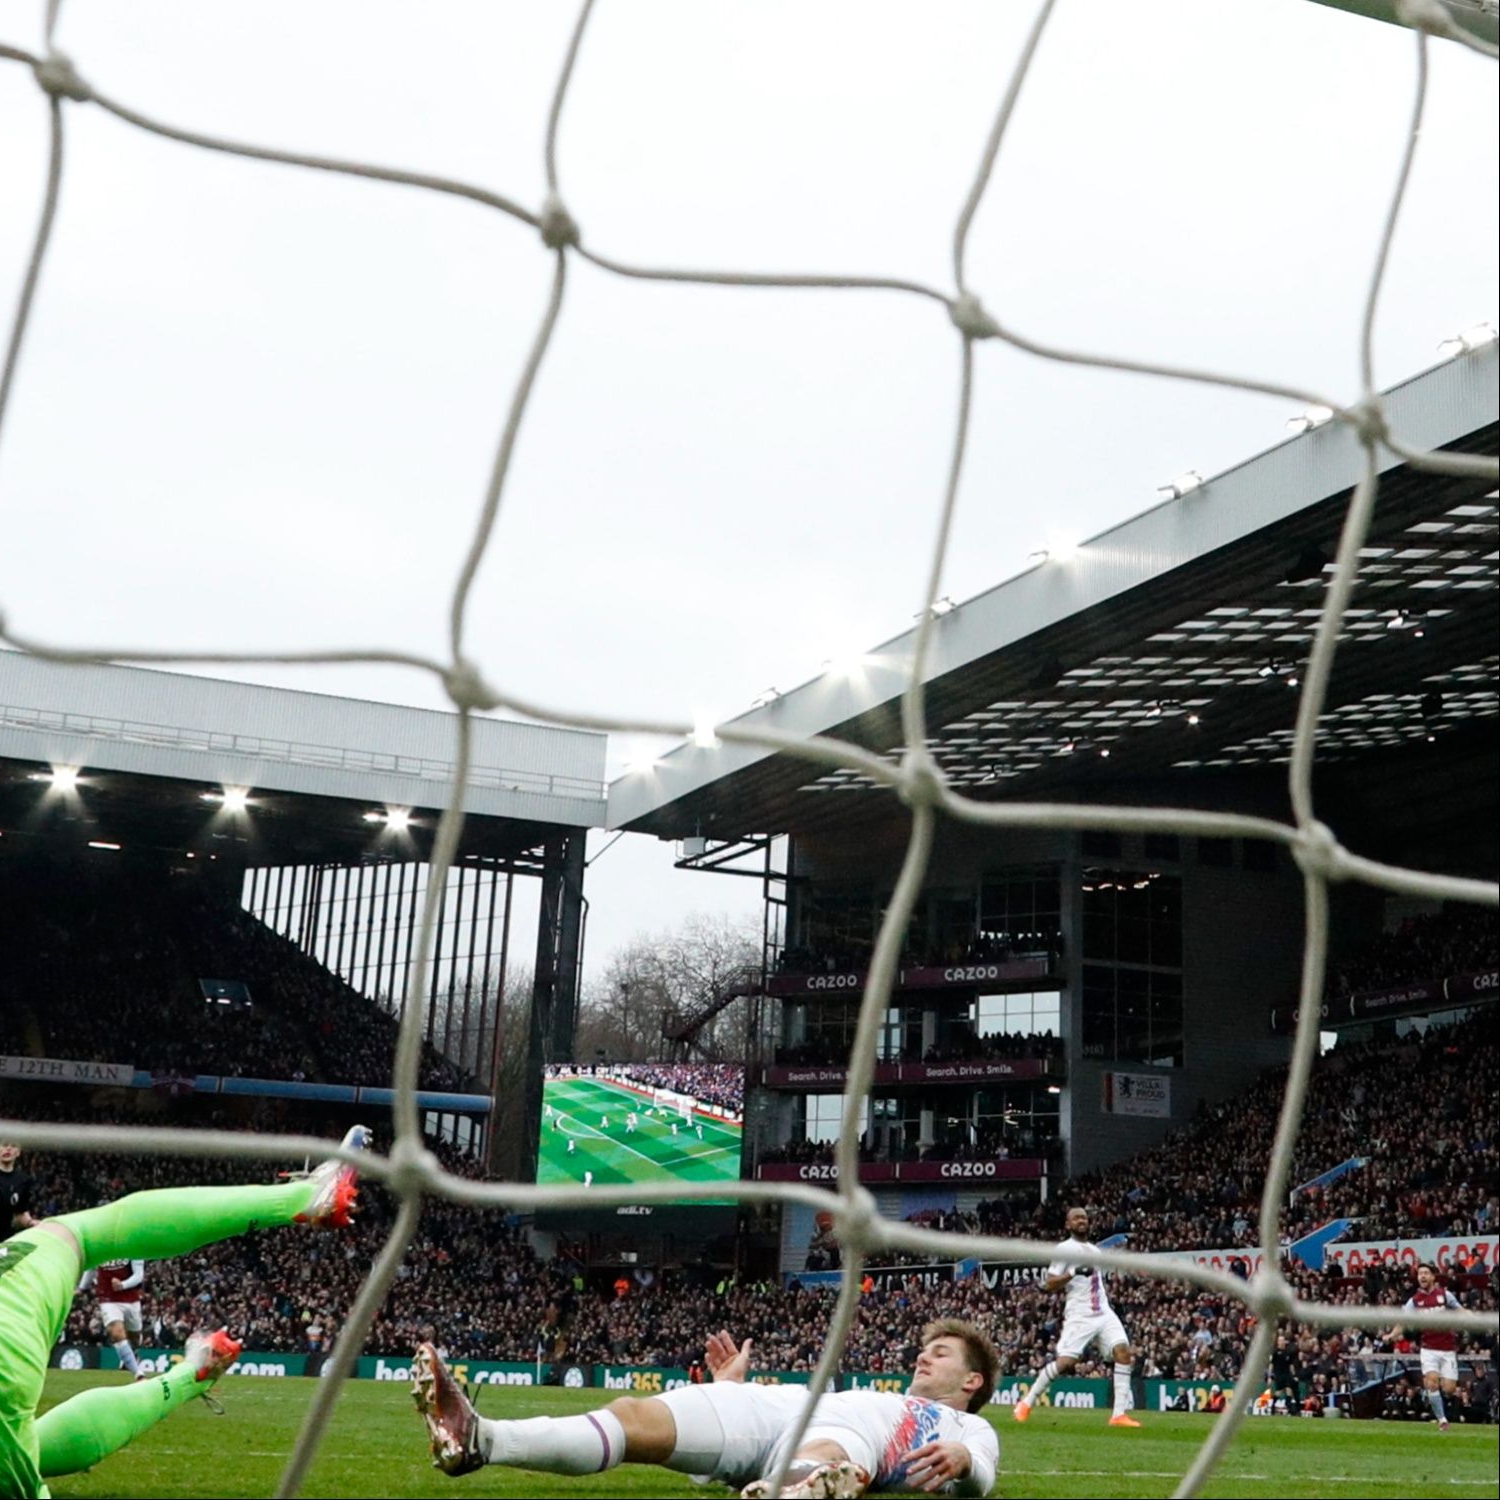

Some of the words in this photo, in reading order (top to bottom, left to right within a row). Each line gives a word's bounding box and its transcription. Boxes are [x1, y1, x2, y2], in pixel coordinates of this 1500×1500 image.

[944, 966, 998, 981] CAZOO
[807, 975, 857, 989] CAZOO
[18, 1063, 65, 1077] 12TH
[73, 1067, 118, 1082] MAN
[926, 1067, 958, 1077] Search.
[960, 1066, 985, 1076] Drive.
[986, 1064, 1015, 1075] Smile.
[800, 1165, 840, 1180] CAZO
[941, 1162, 996, 1176] CAZOO
